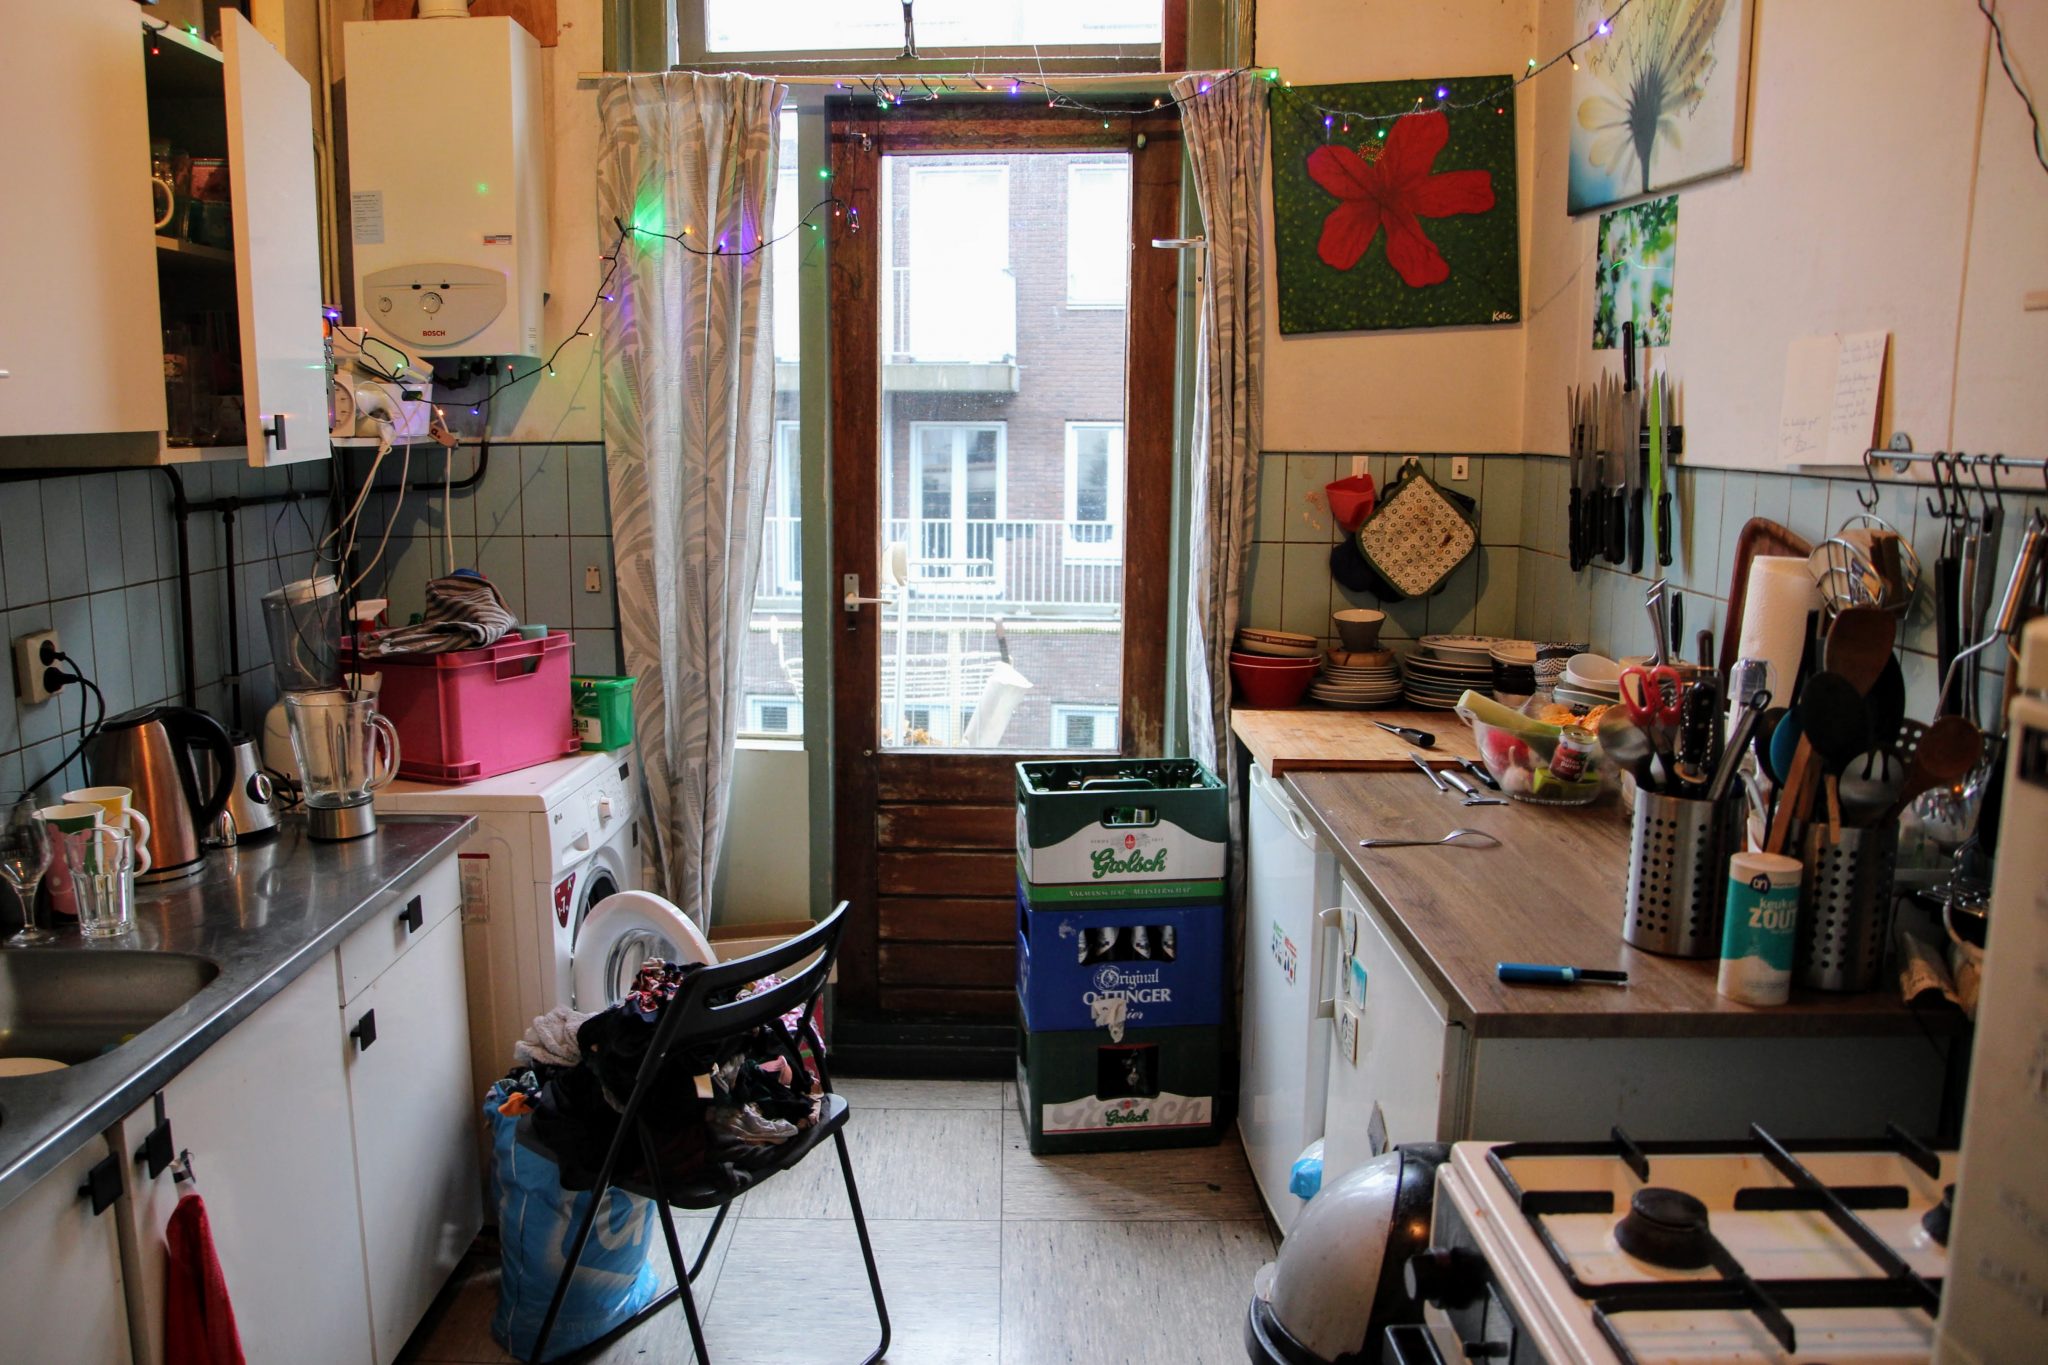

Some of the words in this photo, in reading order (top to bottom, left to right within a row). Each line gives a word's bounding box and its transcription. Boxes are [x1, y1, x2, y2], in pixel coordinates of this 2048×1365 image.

[1090, 848, 1167, 879] Grolsch
[1748, 907, 1798, 929] ZOUT
[1093, 965, 1159, 990] Original
[1126, 1008, 1144, 1020] ier
[1105, 1108, 1149, 1126] Grolsch
